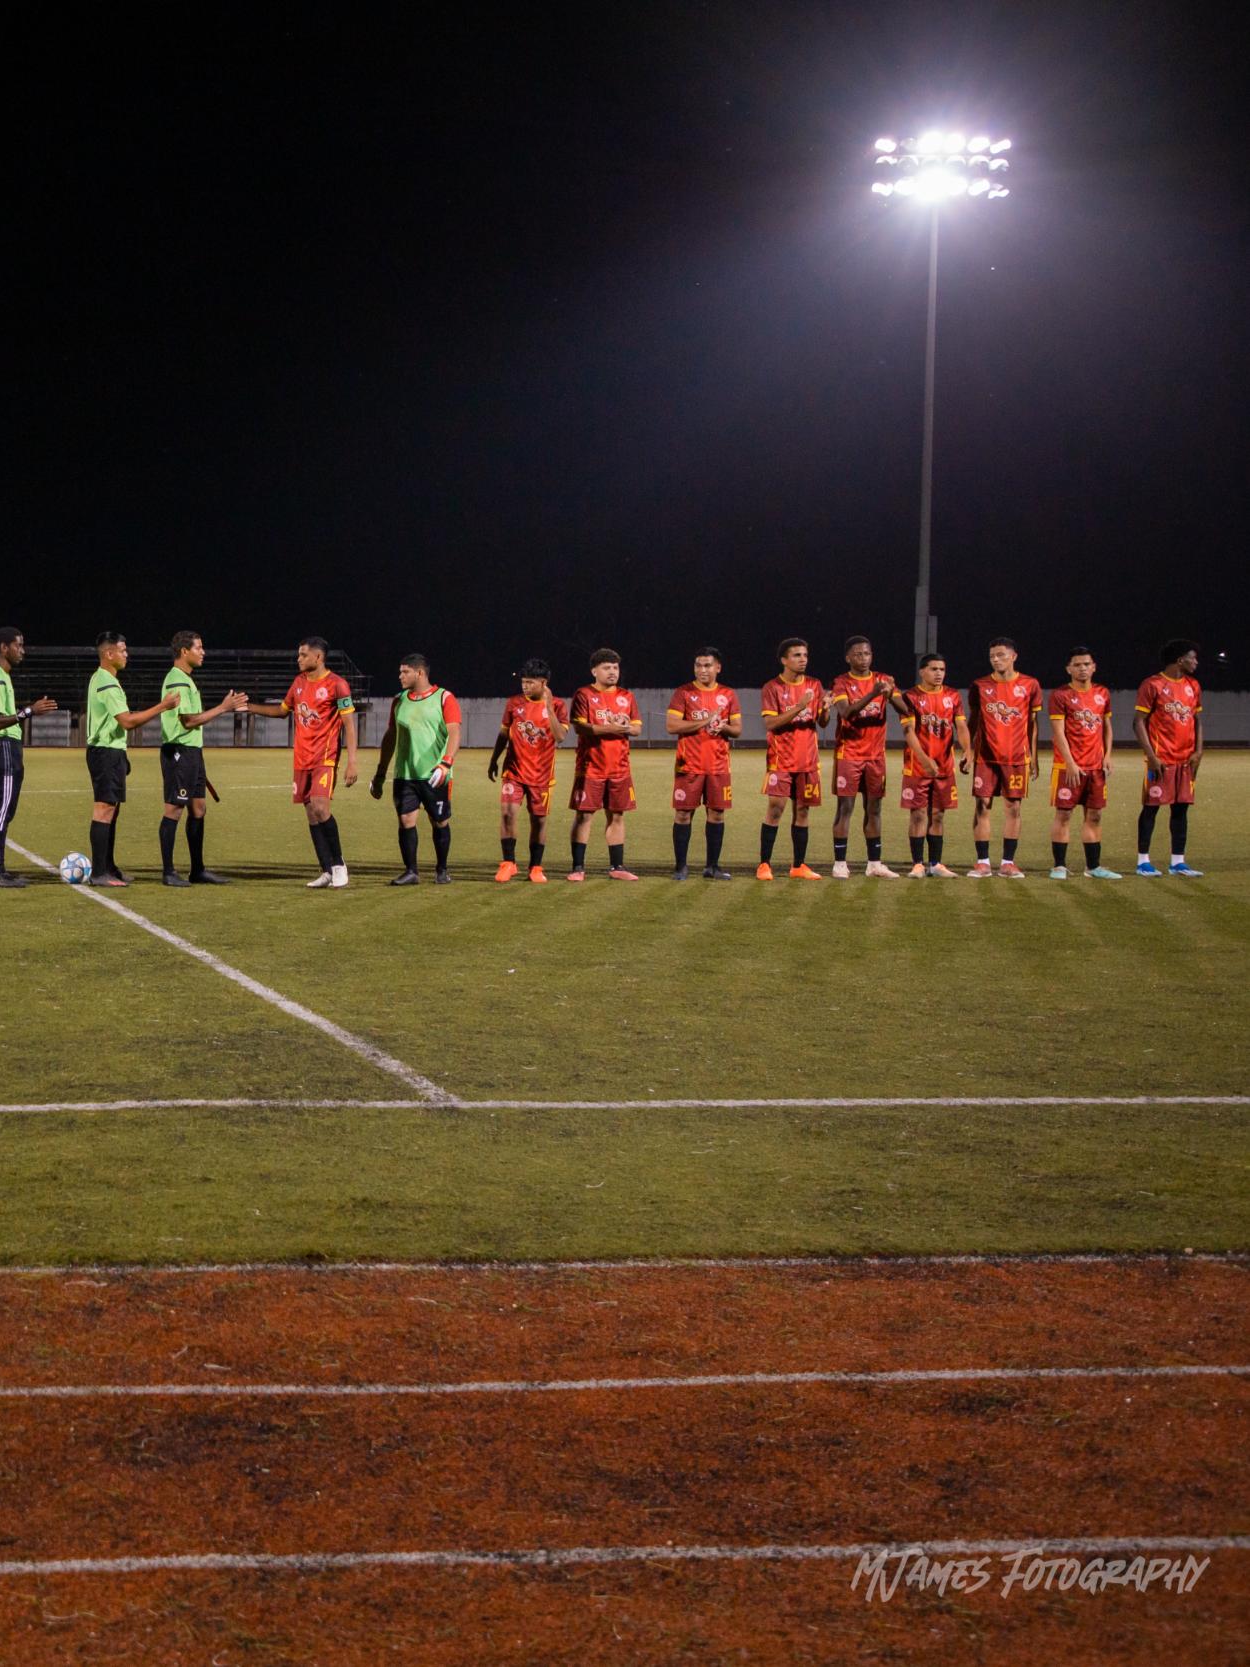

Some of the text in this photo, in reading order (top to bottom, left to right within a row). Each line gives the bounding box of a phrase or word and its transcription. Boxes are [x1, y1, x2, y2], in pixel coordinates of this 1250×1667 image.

[319, 772, 328, 788] 4
[1009, 774, 1024, 790] 23
[541, 791, 549, 807] 7
[804, 783, 820, 799] 24
[436, 800, 444, 815] 7
